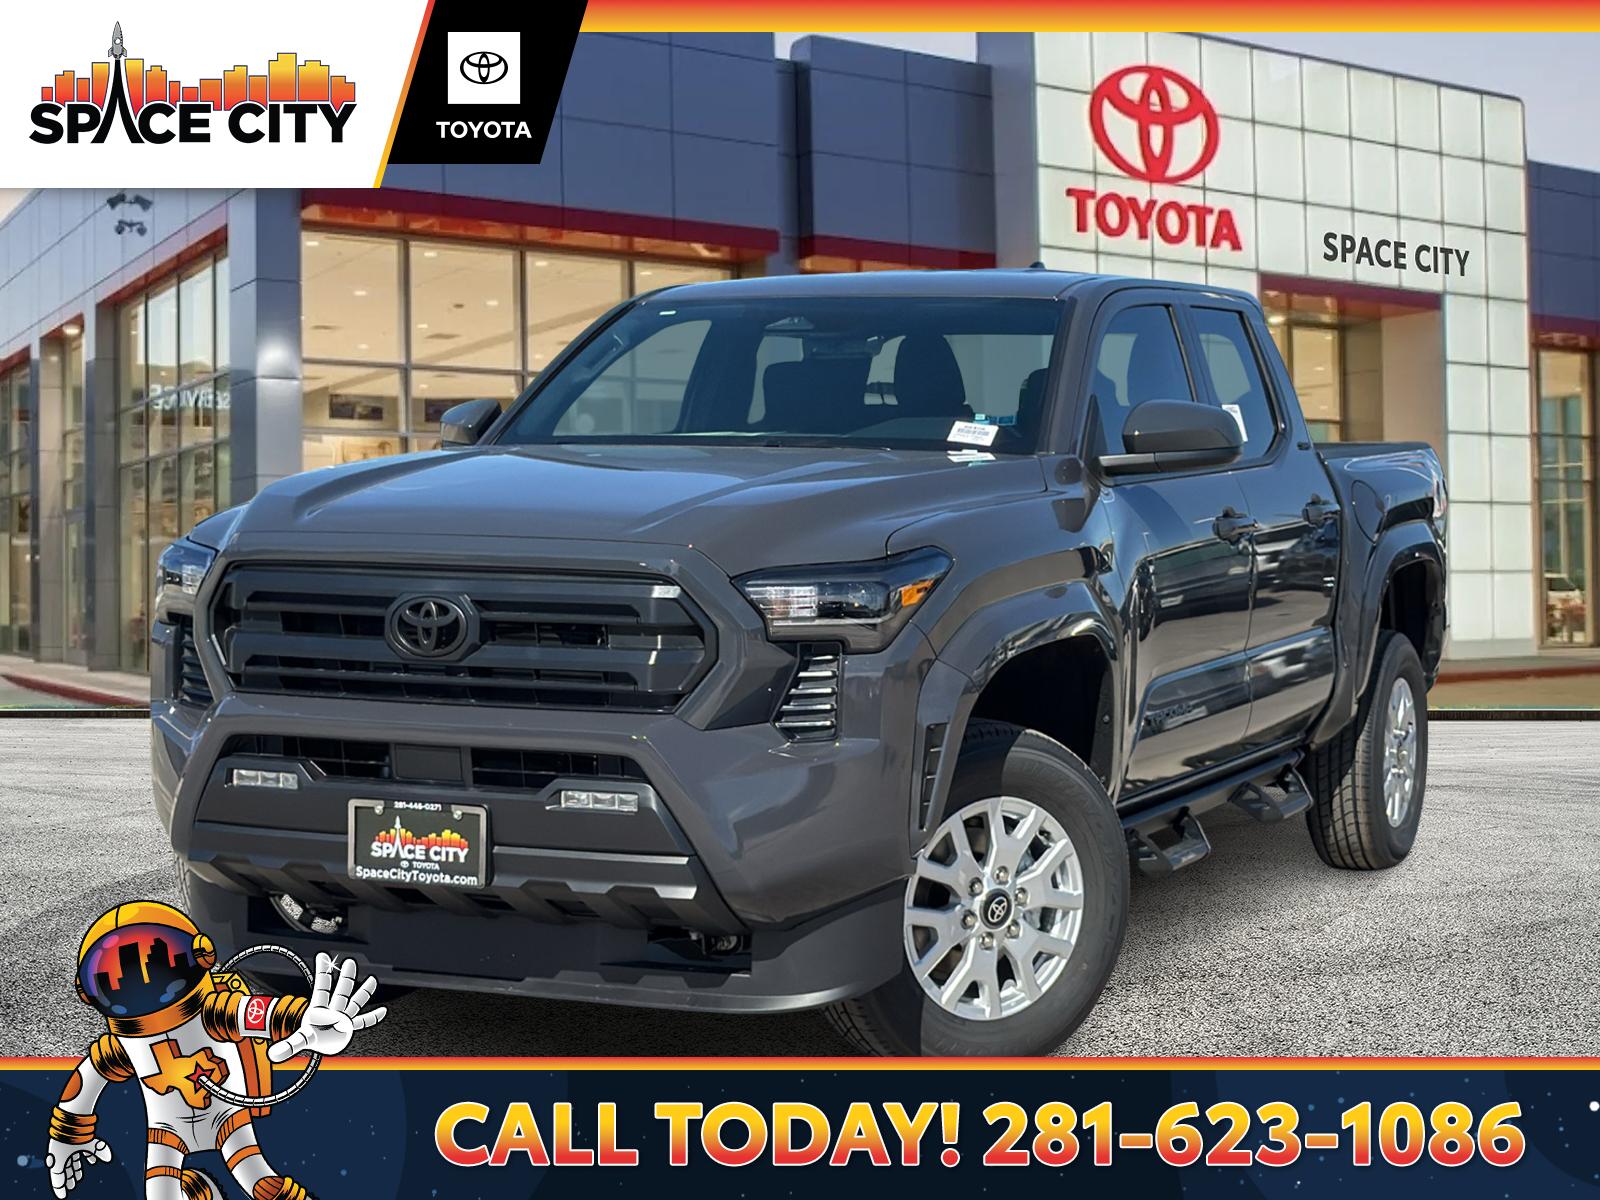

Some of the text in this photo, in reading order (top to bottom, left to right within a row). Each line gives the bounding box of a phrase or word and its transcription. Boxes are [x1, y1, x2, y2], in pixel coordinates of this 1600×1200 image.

[1066, 187, 1242, 251] TOYOTA
[1323, 231, 1470, 277] SPACE CITY
[370, 830, 469, 863] SPACE CITY
[355, 866, 478, 886] SpaceCityToyota.com
[412, 861, 440, 871] TOYOTA
